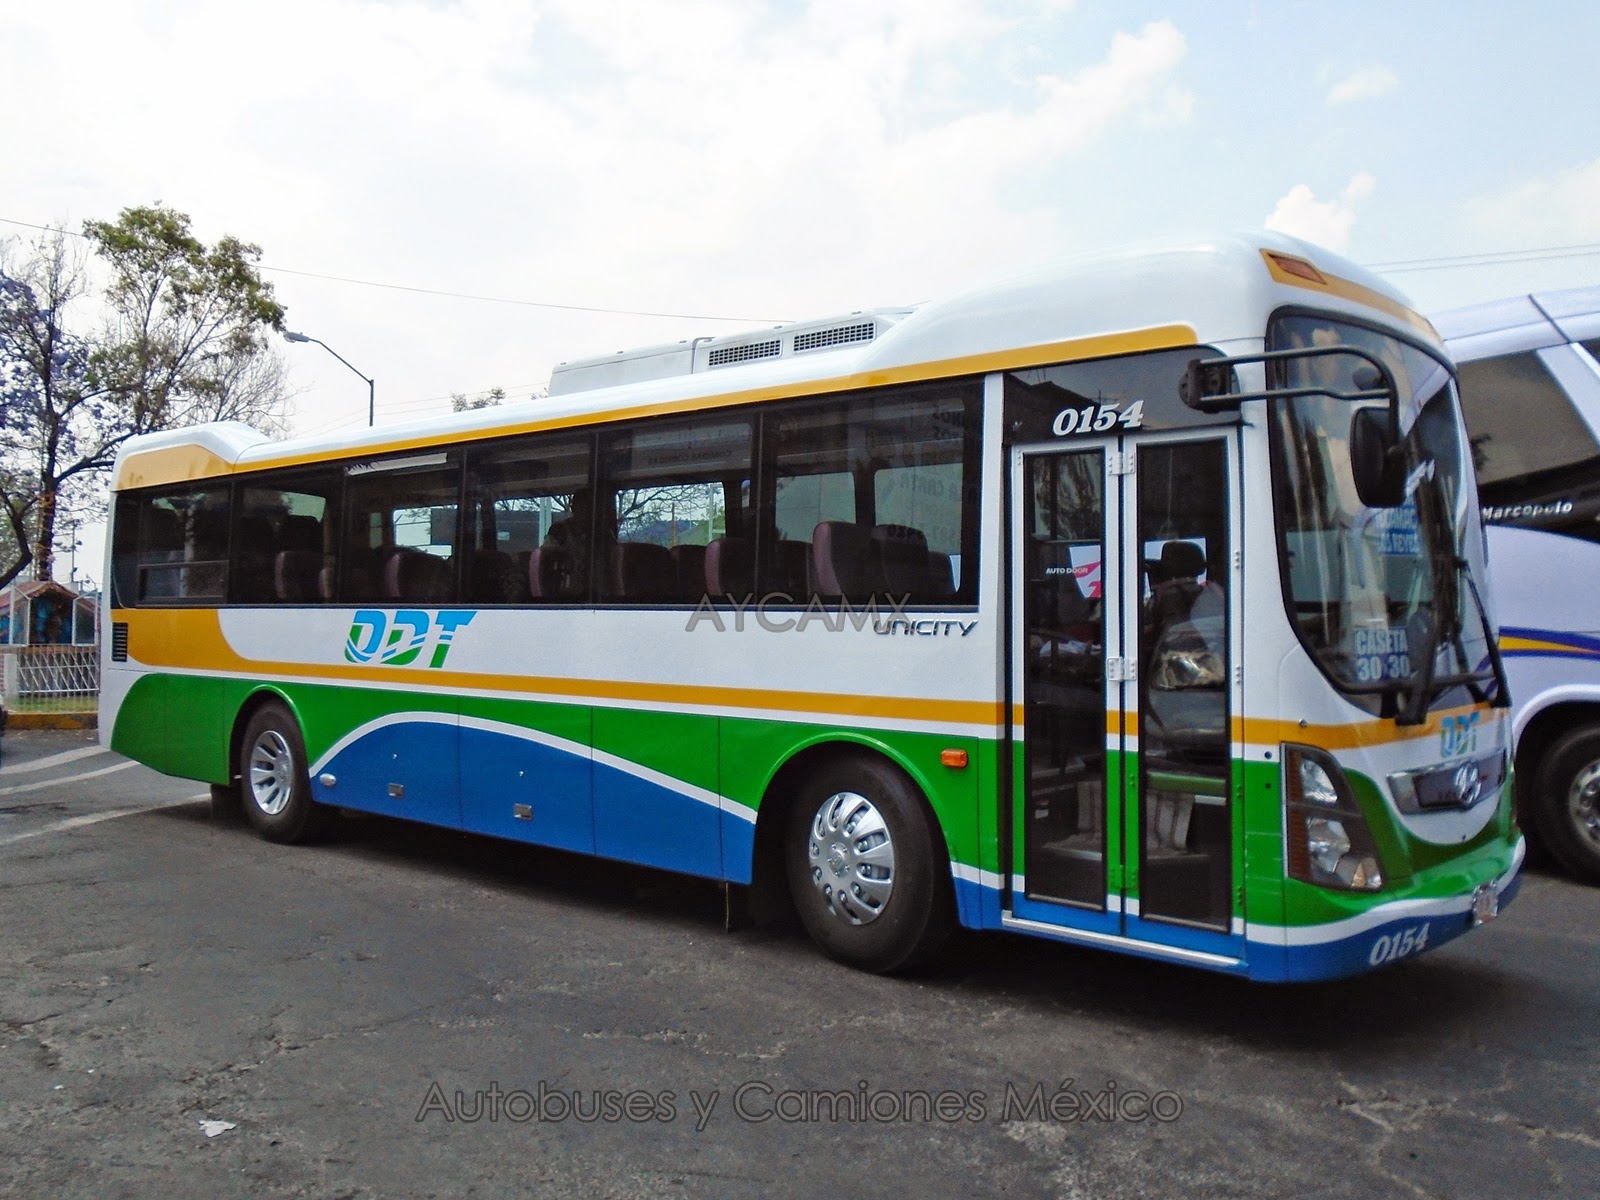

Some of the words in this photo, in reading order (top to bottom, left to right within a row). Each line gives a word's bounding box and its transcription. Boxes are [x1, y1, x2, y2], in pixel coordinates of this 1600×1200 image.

[1053, 400, 1144, 436] 0154
[345, 610, 478, 668] ODT
[1356, 629, 1408, 655] CASETA
[1369, 923, 1430, 966] 0154
